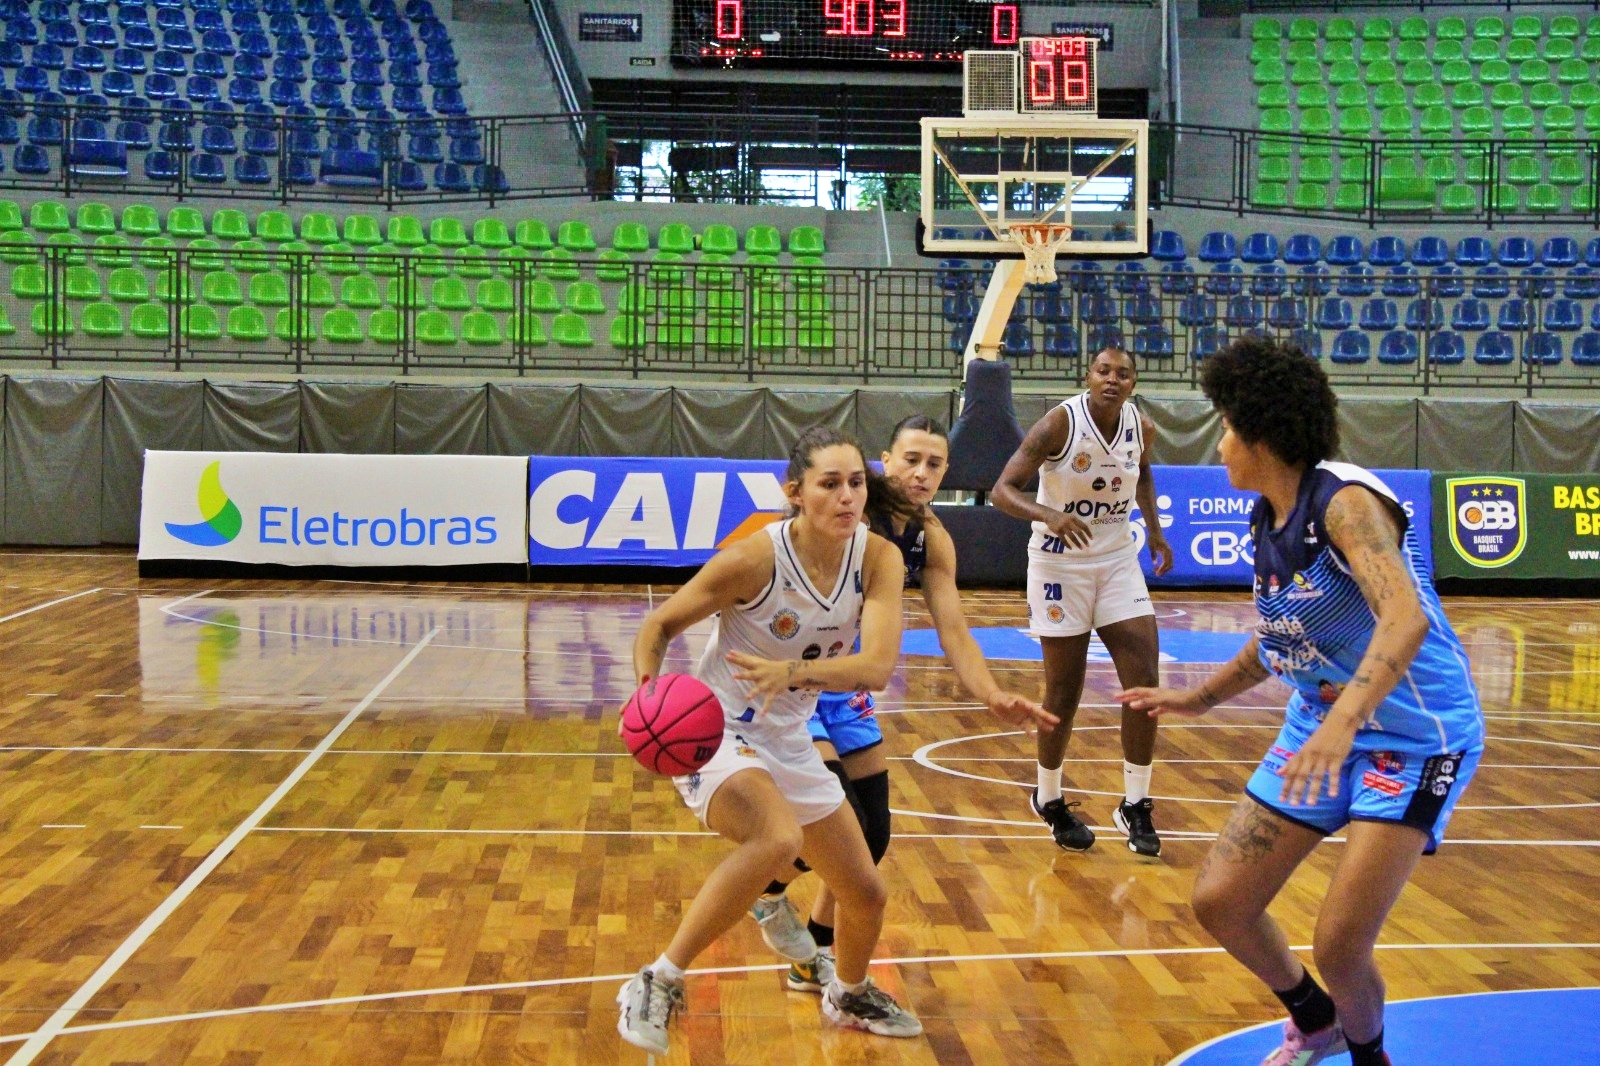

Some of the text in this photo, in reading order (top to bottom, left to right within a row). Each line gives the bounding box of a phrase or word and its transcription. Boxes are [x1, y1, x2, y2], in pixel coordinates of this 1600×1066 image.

[993, 5, 1017, 44] 0
[1030, 60, 1088, 101] 08
[259, 505, 498, 547] Eletrobras
[1458, 500, 1517, 531] CBB
[1473, 535, 1504, 545] BASQUETE
[1478, 544, 1500, 553] BRASIL
[1044, 583, 1063, 601] 20
